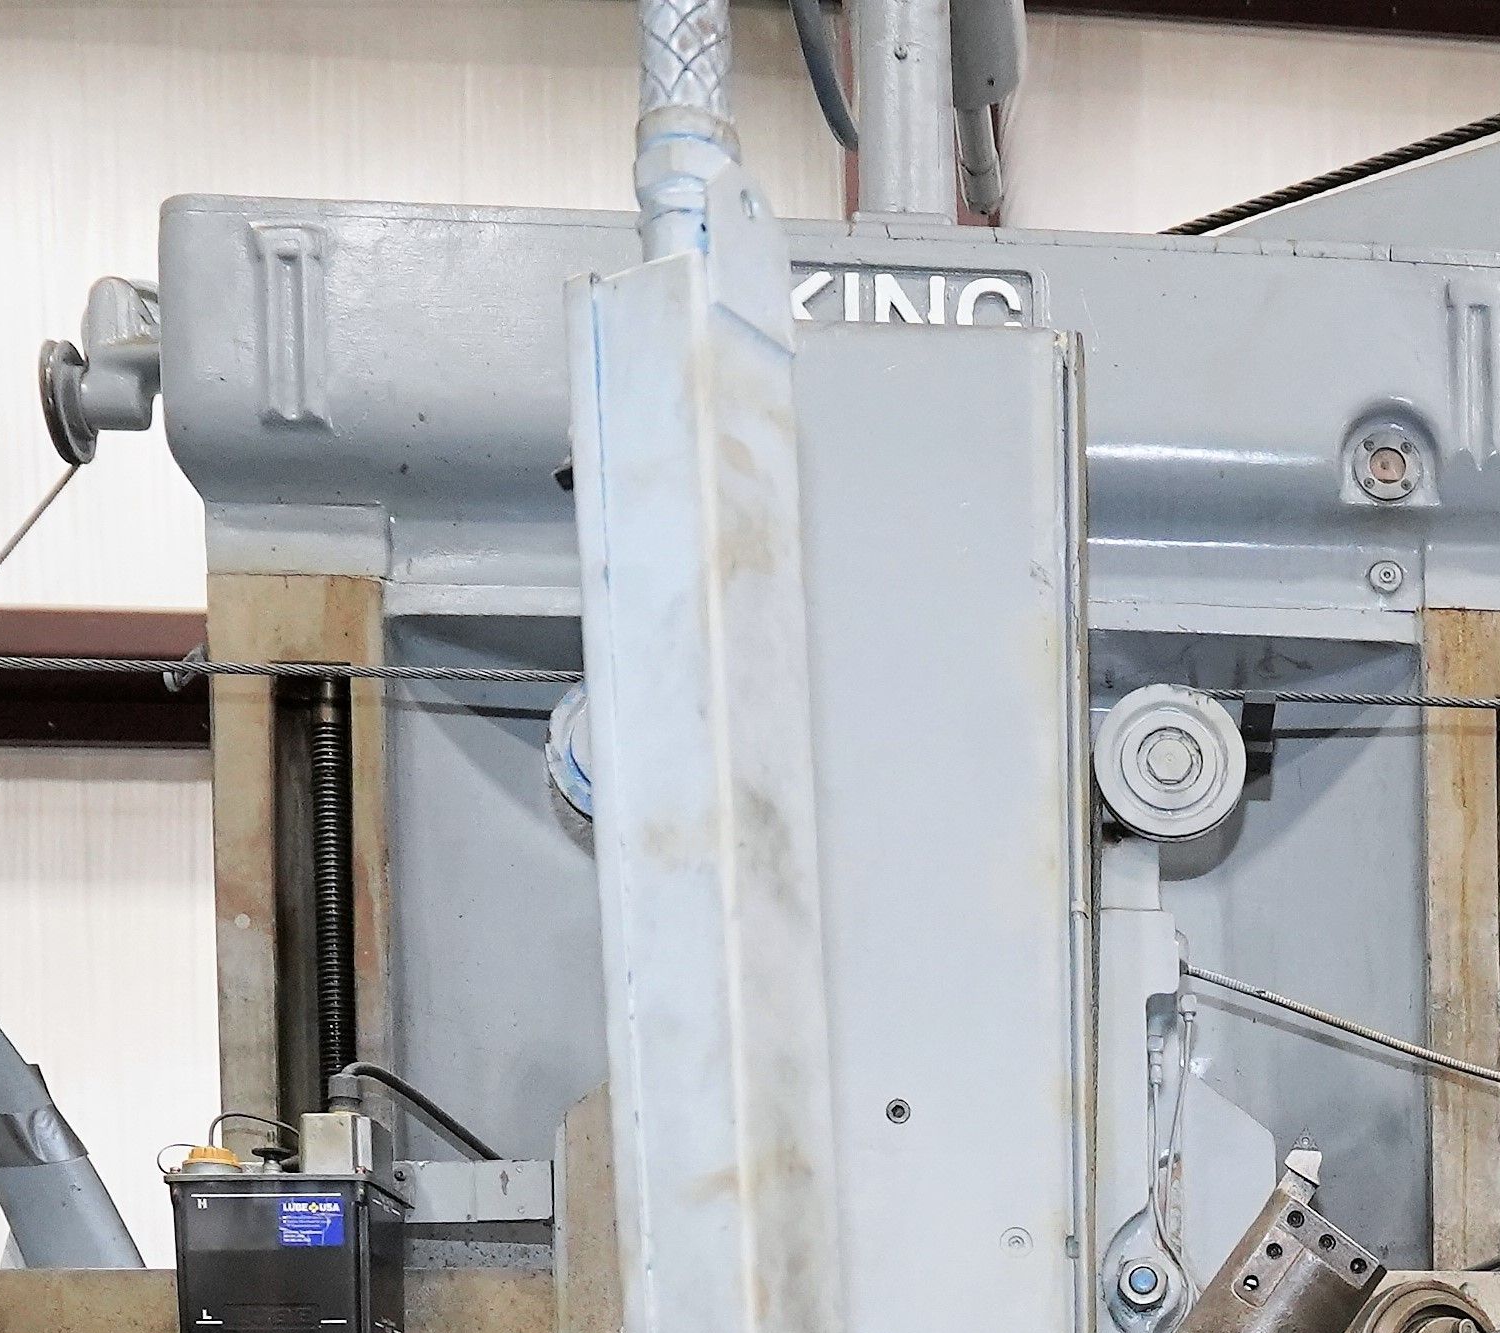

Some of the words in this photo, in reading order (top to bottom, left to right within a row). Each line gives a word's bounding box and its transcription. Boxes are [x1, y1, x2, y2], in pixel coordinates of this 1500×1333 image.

[282, 1202, 309, 1212] LUBE
[318, 1202, 341, 1212] USA
[202, 1309, 213, 1320] L
